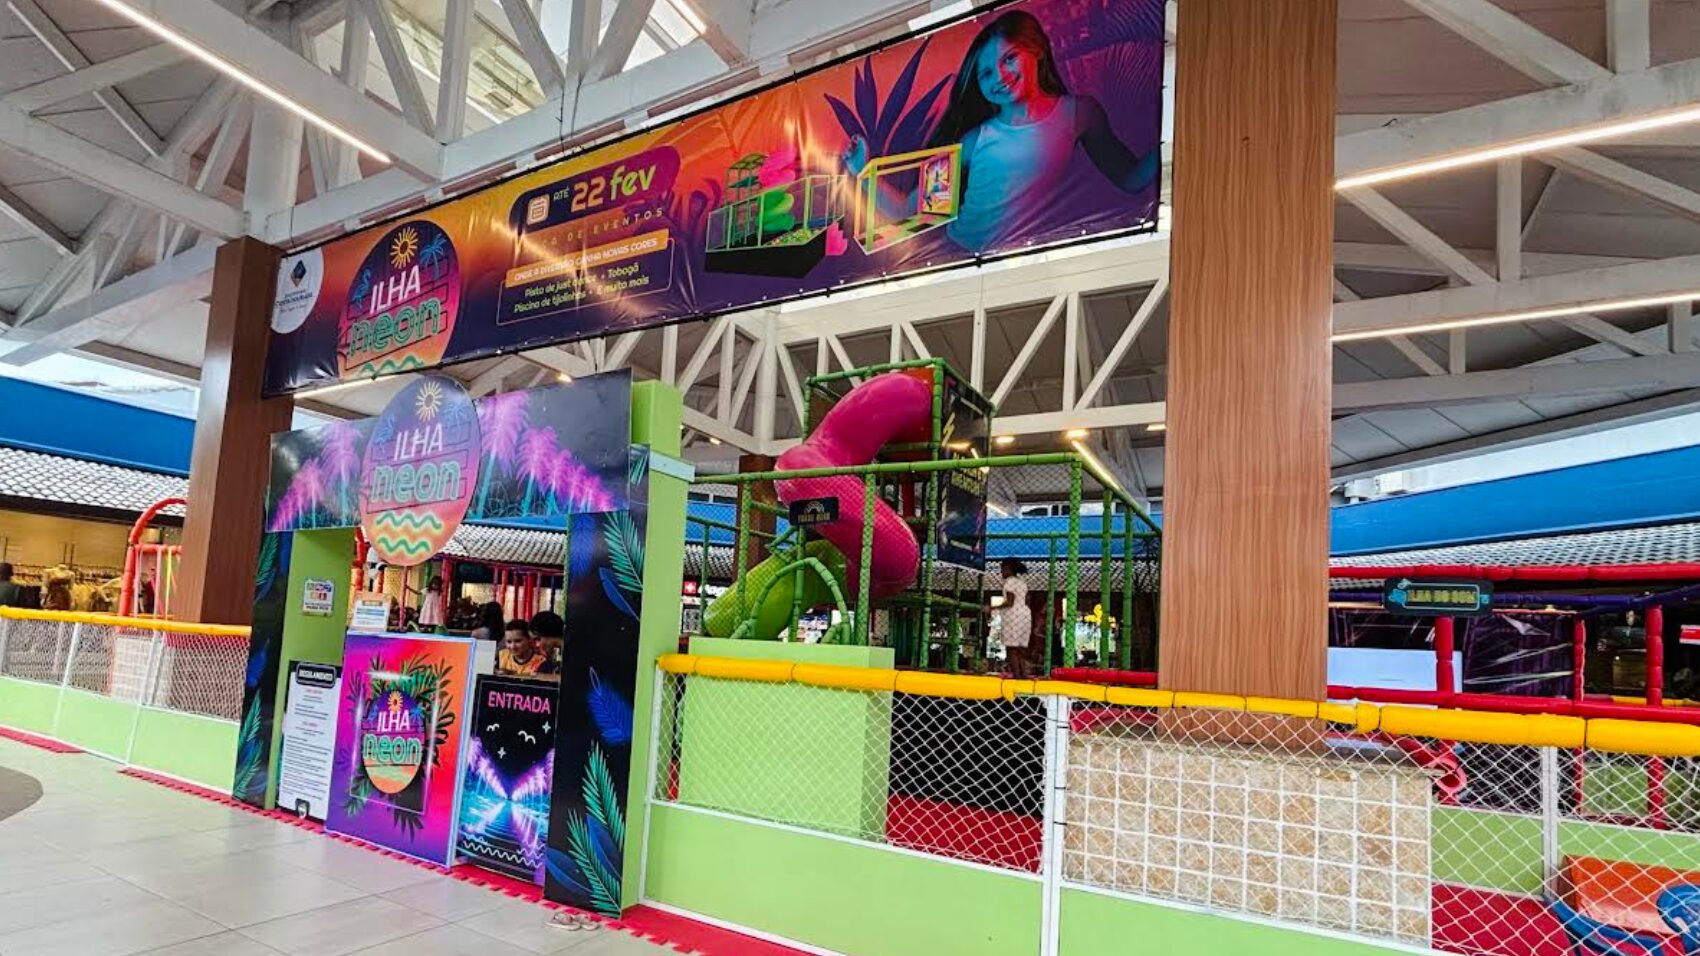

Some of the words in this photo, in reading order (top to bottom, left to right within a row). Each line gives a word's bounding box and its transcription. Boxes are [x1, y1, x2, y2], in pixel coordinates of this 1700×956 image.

[553, 186, 571, 201] ATÉ
[571, 176, 606, 213] 22
[610, 165, 656, 200] fev
[593, 208, 663, 235] EVENTOS
[602, 245, 629, 259] NOVAS
[631, 237, 657, 251] CORES
[369, 264, 422, 316] ILHA
[513, 300, 540, 314] Piscina
[629, 274, 649, 288] mais
[525, 285, 544, 298] Pista
[608, 262, 639, 278] Tobogã
[347, 298, 441, 358] neon
[394, 422, 443, 461] ILHA
[371, 459, 460, 503] neon
[376, 708, 411, 733] ILHA
[487, 690, 552, 715] ENTRADA
[362, 731, 422, 765] neon
